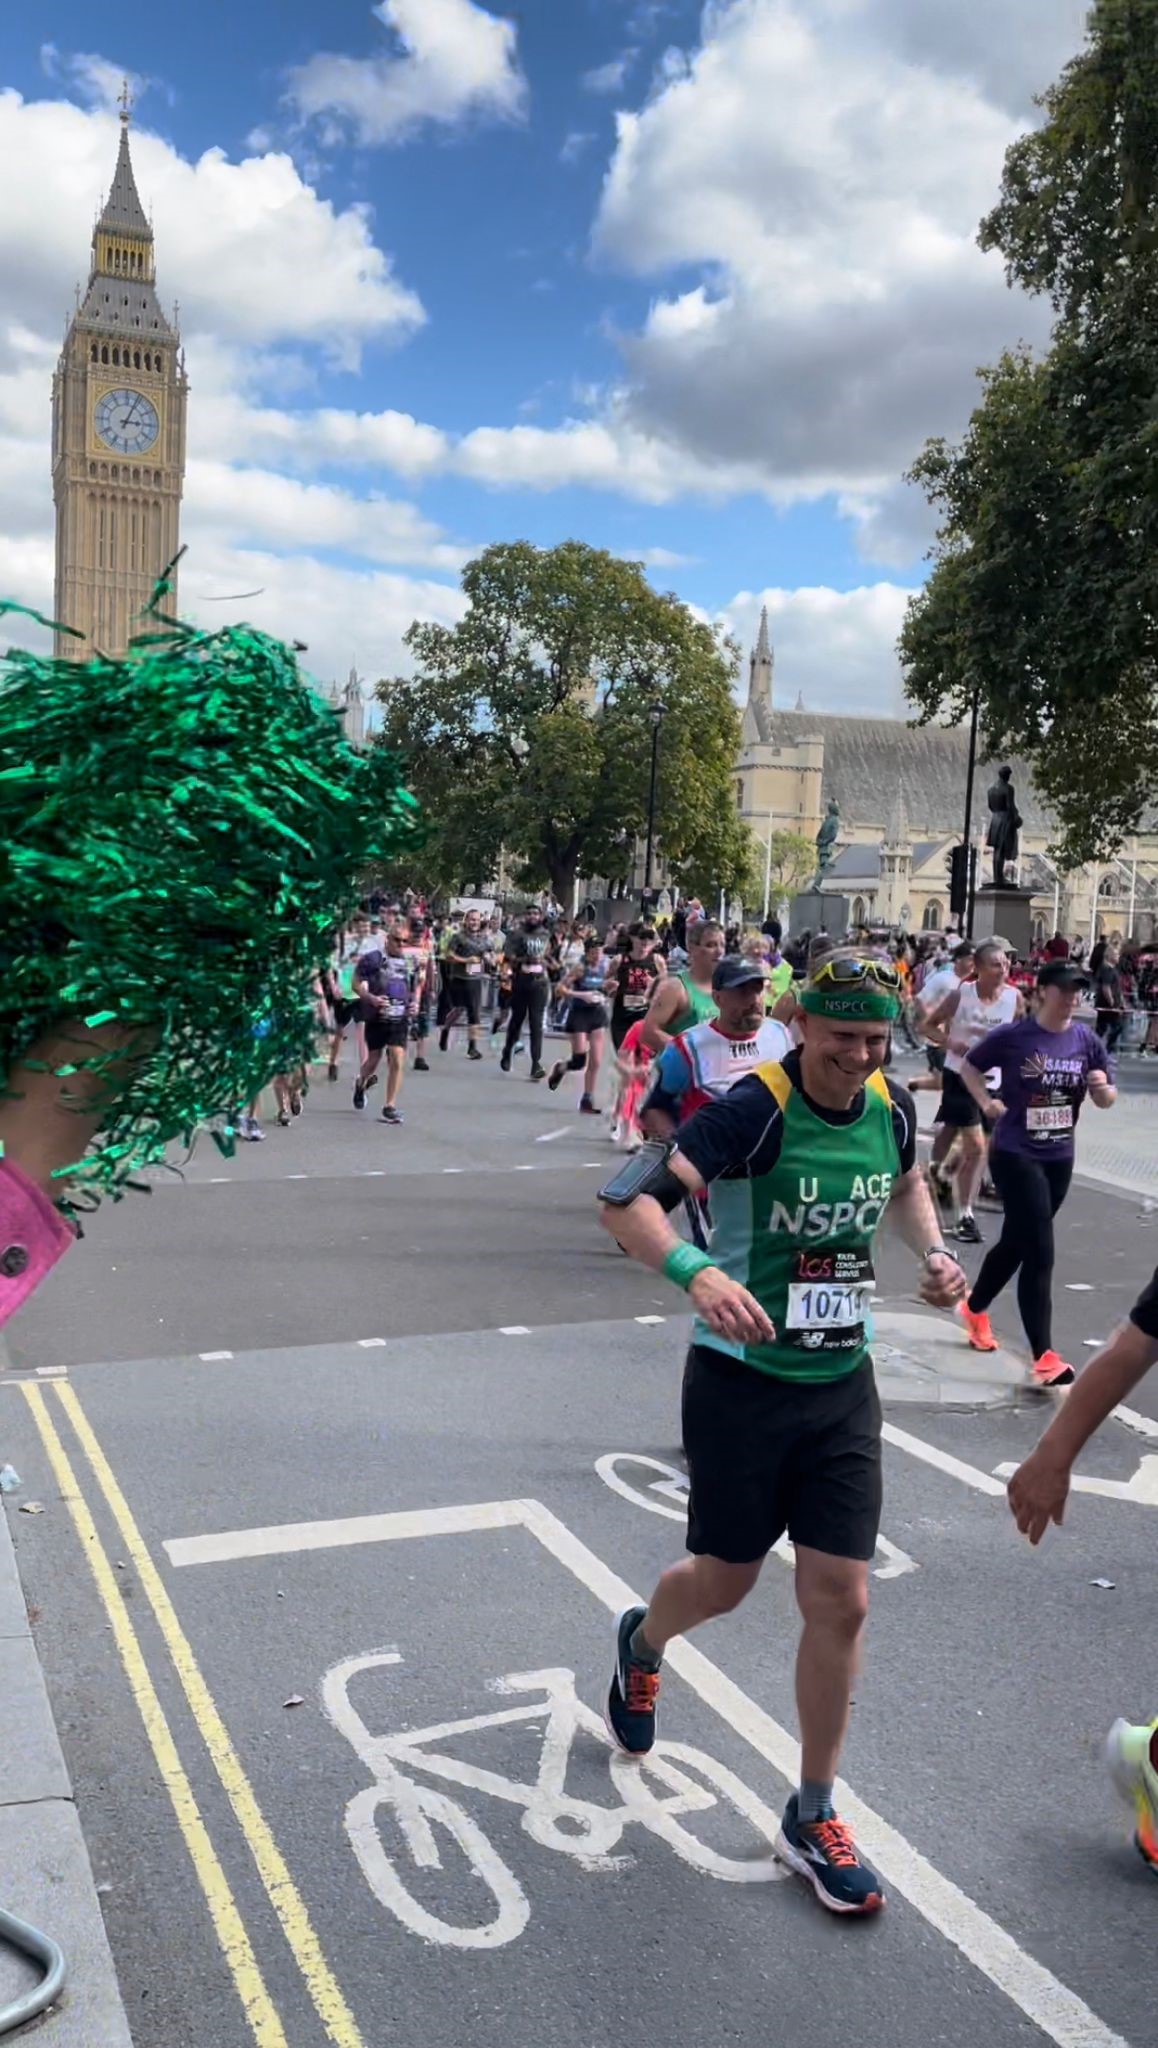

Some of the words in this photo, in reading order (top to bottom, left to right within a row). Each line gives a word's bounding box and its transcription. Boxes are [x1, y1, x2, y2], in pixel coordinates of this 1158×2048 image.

[824, 1000, 868, 1012] NSPCC
[799, 1177, 818, 1202] U
[849, 1172, 892, 1200] ACE
[769, 1199, 889, 1237] NSPC
